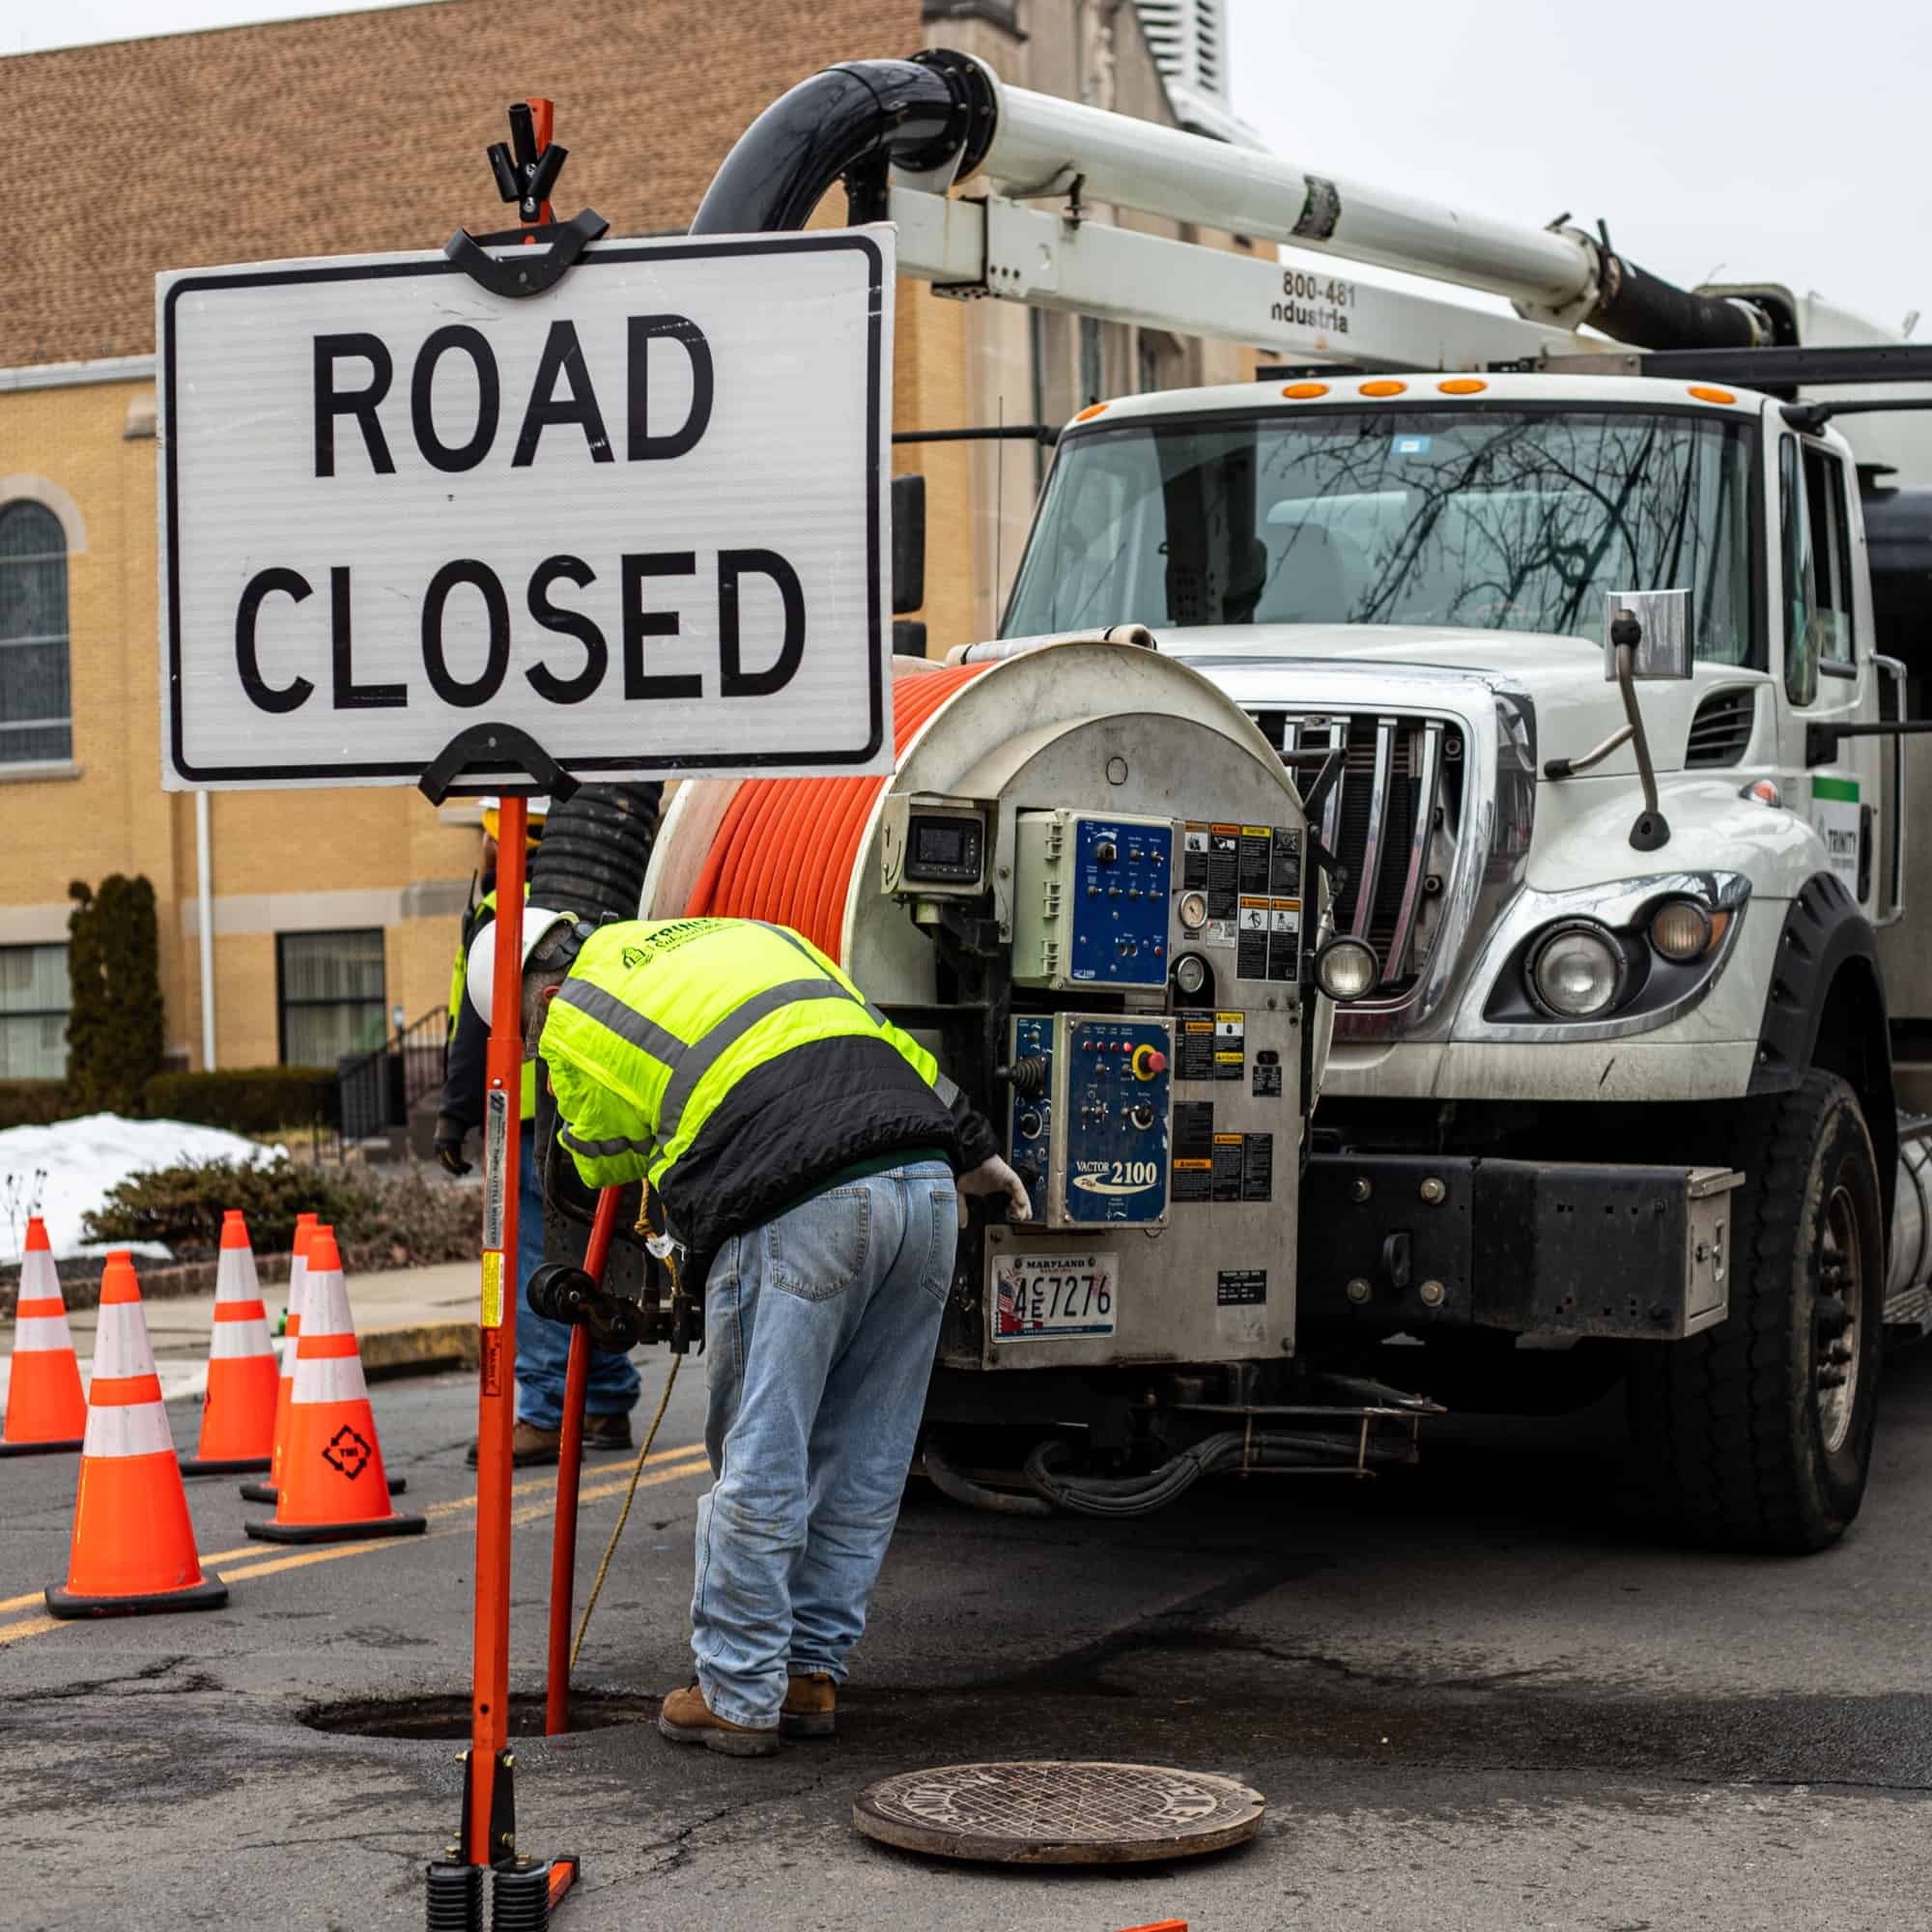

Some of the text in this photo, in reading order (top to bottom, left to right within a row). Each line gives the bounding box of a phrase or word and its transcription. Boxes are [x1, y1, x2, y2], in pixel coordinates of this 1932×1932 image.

[314, 314, 714, 477] ROAD
[235, 549, 806, 714] CLOSED
[1076, 1160, 1111, 1173] VACTOR
[1111, 1161, 1157, 1184] 2100
[1026, 1259, 1085, 1269] MARYLAND
